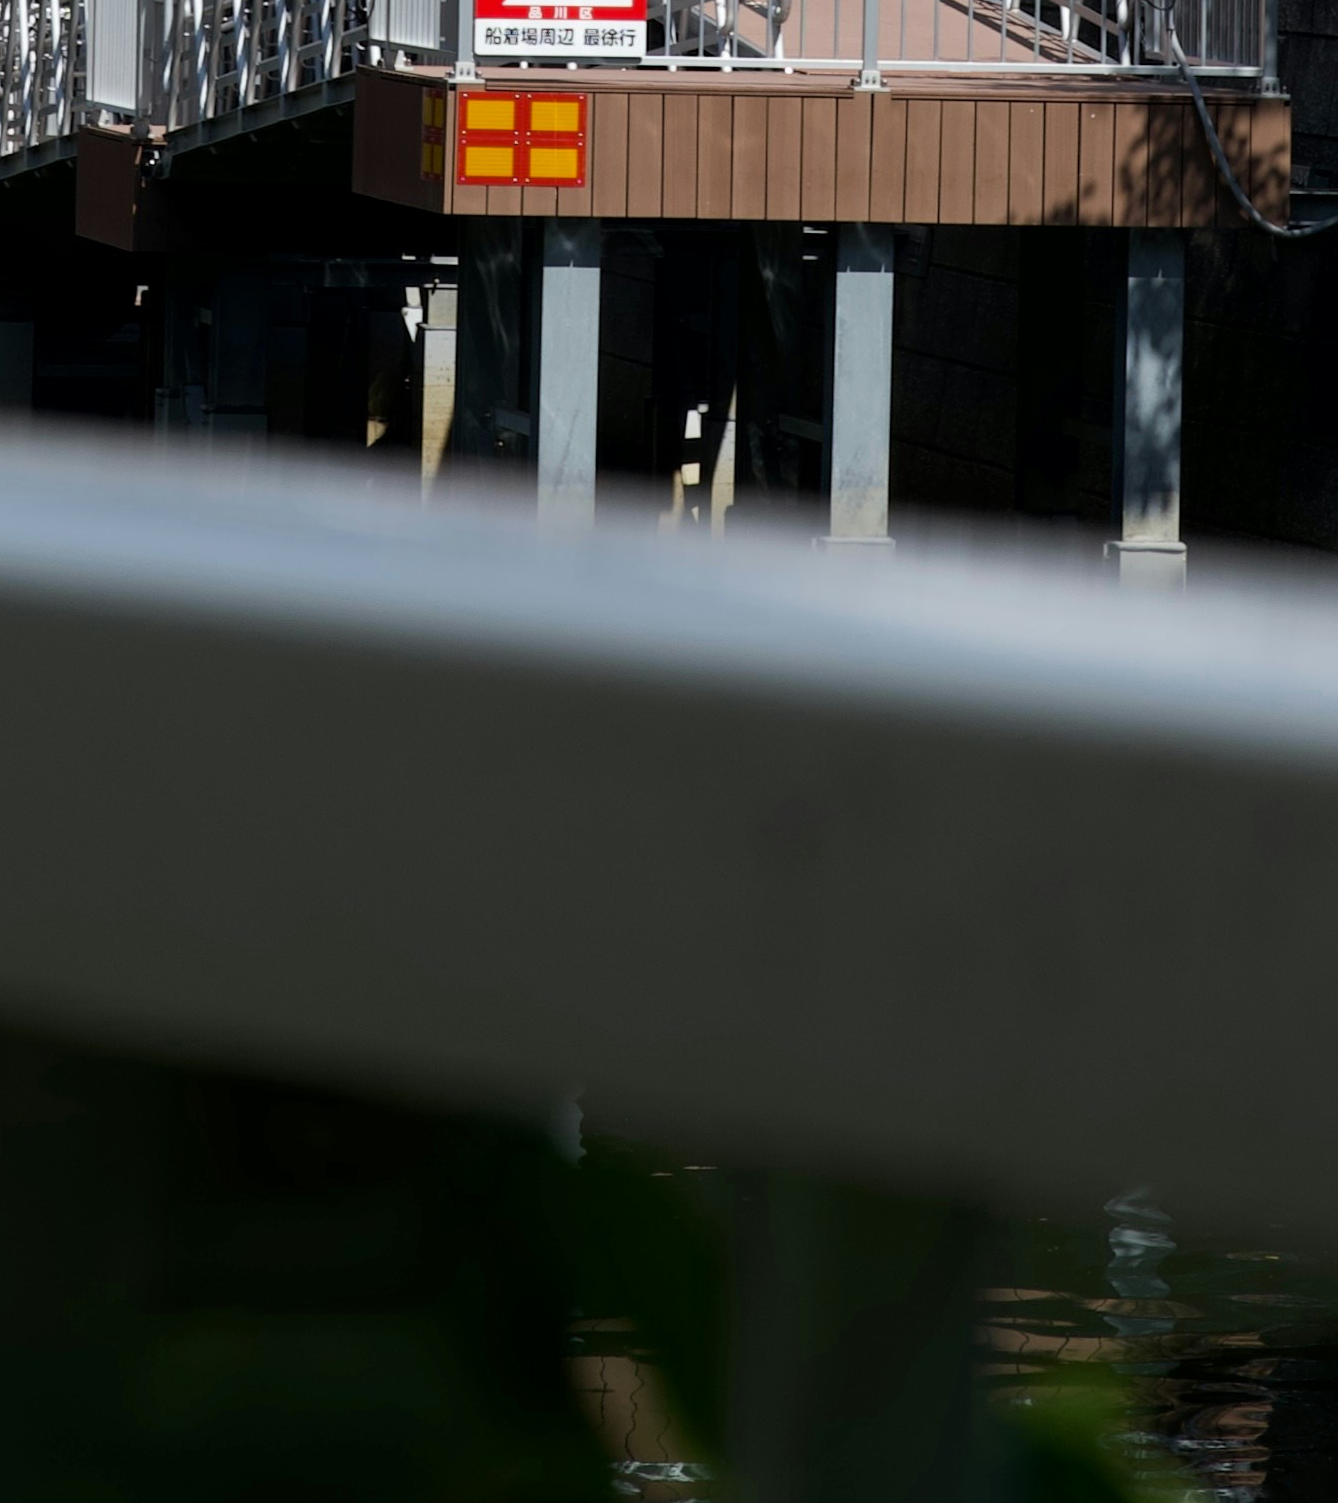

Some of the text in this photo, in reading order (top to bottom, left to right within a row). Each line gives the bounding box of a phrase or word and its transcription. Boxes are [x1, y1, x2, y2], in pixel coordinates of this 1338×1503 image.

[528, 6, 593, 20] 品川区
[584, 27, 636, 47] 最徐行
